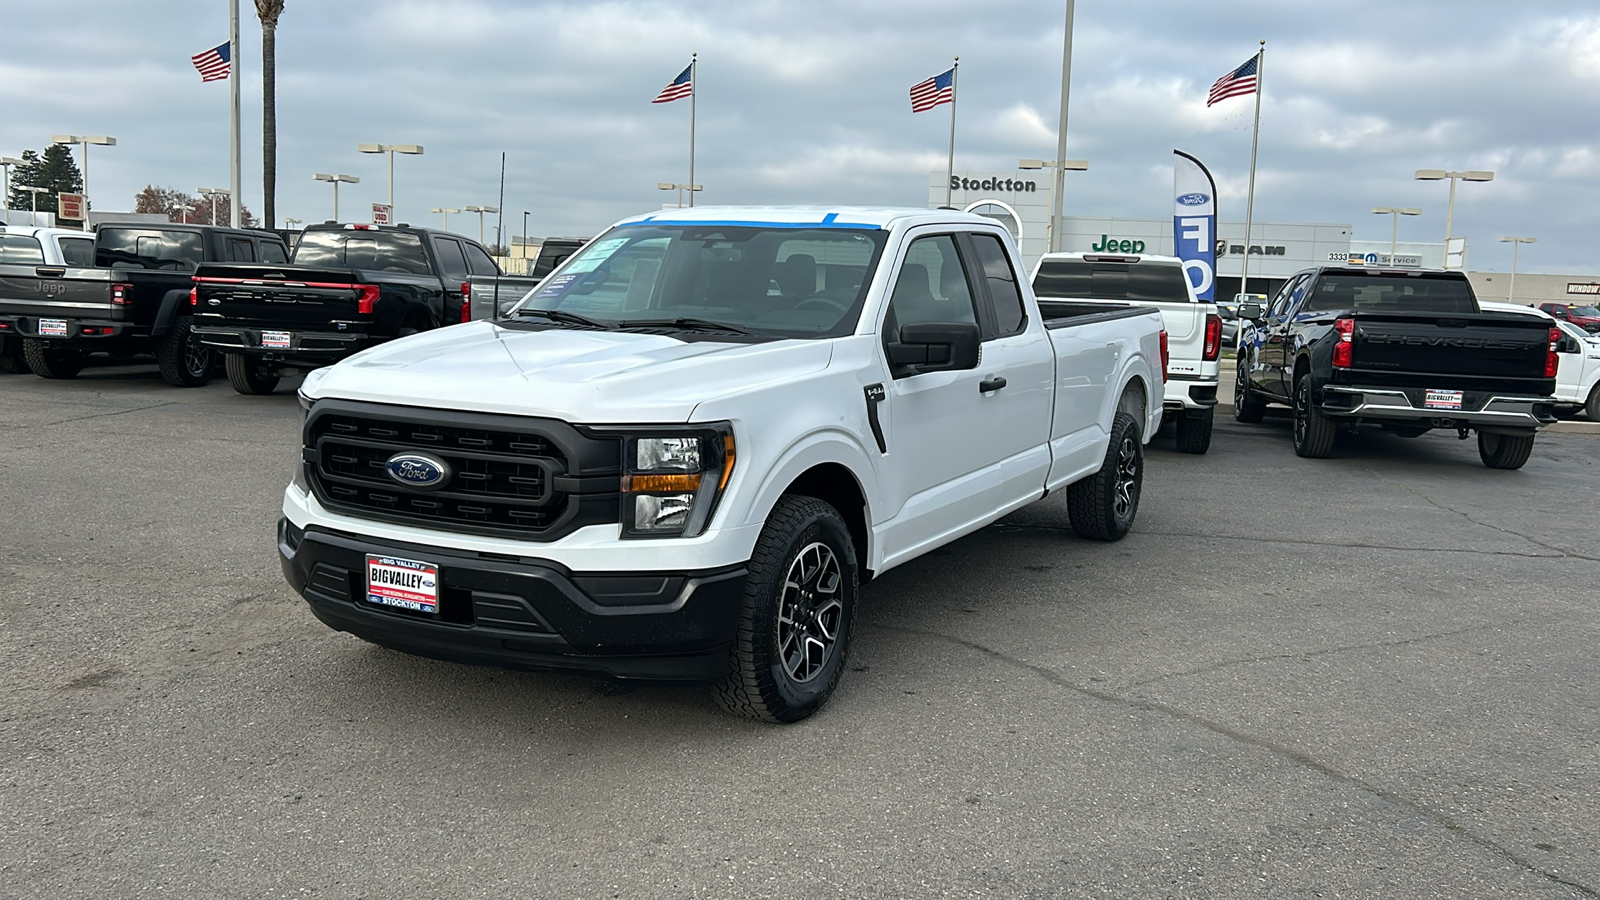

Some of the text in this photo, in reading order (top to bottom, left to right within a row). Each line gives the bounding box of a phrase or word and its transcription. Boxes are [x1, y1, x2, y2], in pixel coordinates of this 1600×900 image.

[950, 175, 1036, 192] Stockton
[1092, 234, 1145, 254] Jeep
[1230, 244, 1286, 256] RAM
[1329, 253, 1348, 261] 3333
[1382, 256, 1417, 264] Service
[35, 281, 67, 295] Jeep
[1568, 285, 1599, 293] WINDOW
[1367, 334, 1536, 350] CHEVROLET
[398, 461, 430, 480] Ford
[396, 560, 421, 570] VALLEY
[371, 568, 423, 589] BIGVALLEY
[382, 598, 421, 610] STOCKTON
